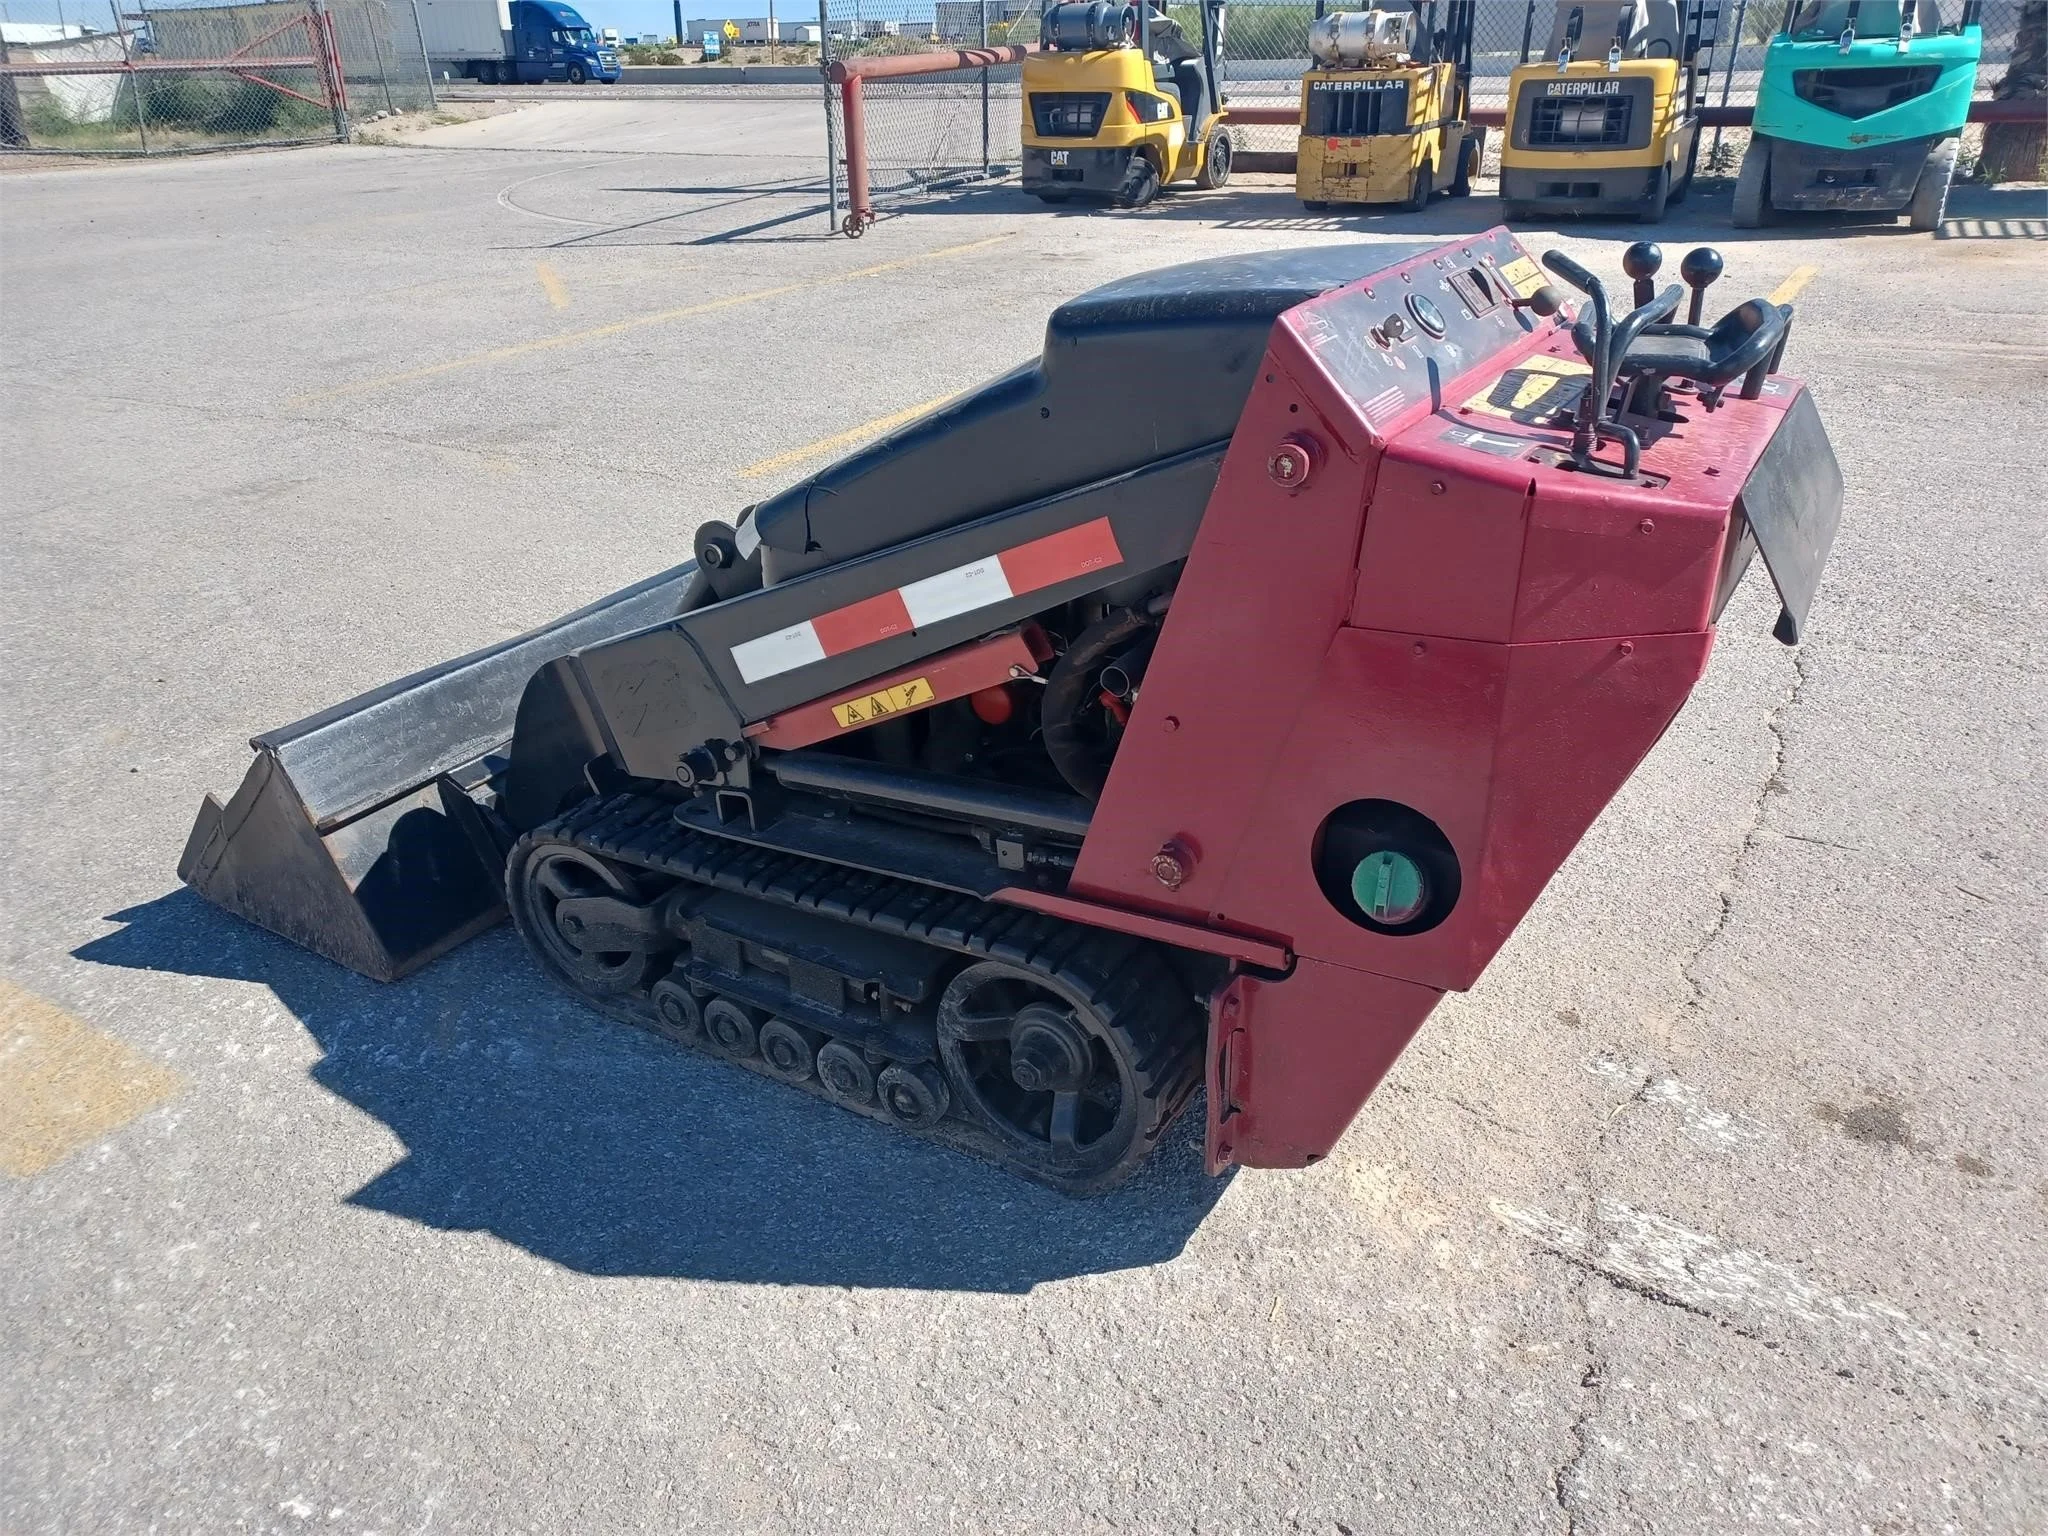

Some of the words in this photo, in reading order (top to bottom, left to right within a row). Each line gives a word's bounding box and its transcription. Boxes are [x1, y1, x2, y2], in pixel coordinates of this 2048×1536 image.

[1313, 80, 1404, 91] CATERPILLAR
[1547, 81, 1620, 96] CATERPILLAR
[1157, 102, 1169, 119] CAT
[1051, 151, 1070, 165] CAT
